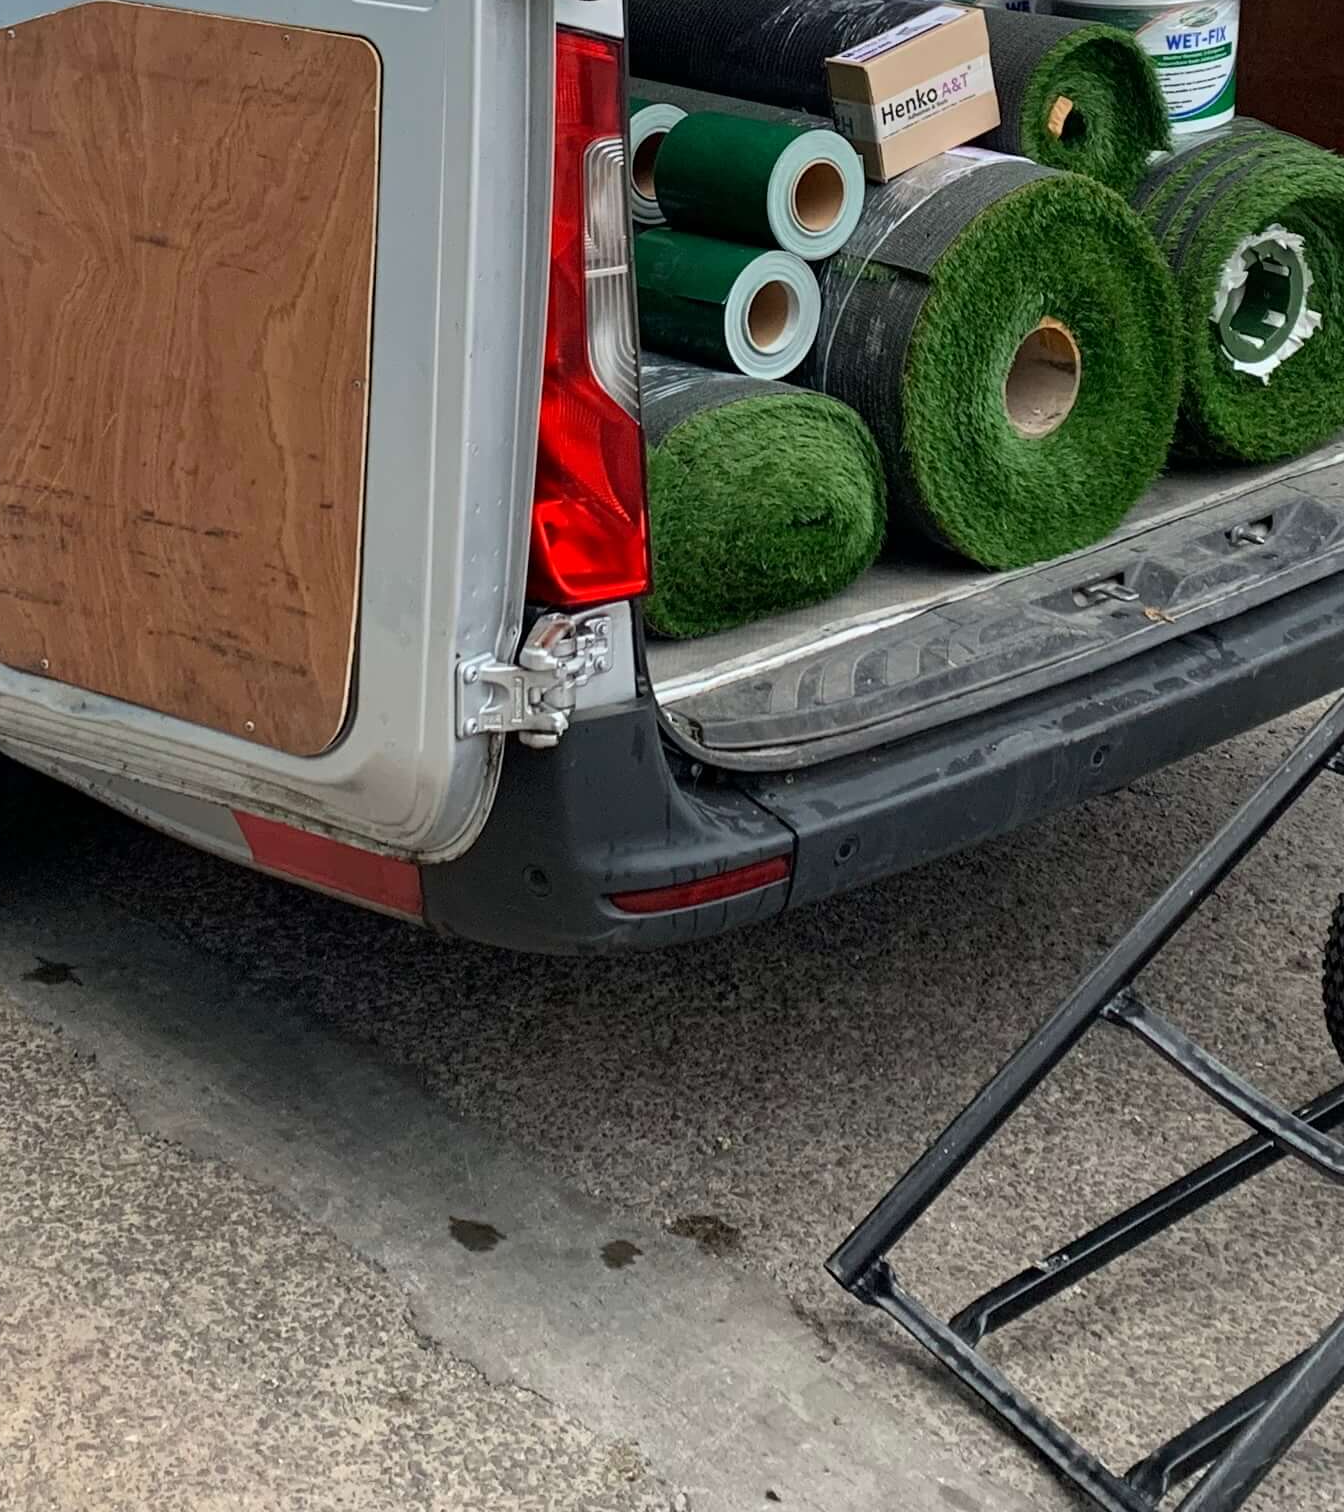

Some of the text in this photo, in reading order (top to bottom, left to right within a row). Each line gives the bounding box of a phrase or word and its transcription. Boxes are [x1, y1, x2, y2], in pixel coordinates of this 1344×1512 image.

[1166, 25, 1227, 50] WET-FIX
[881, 88, 938, 125] Henko
[942, 72, 968, 98] A&T
